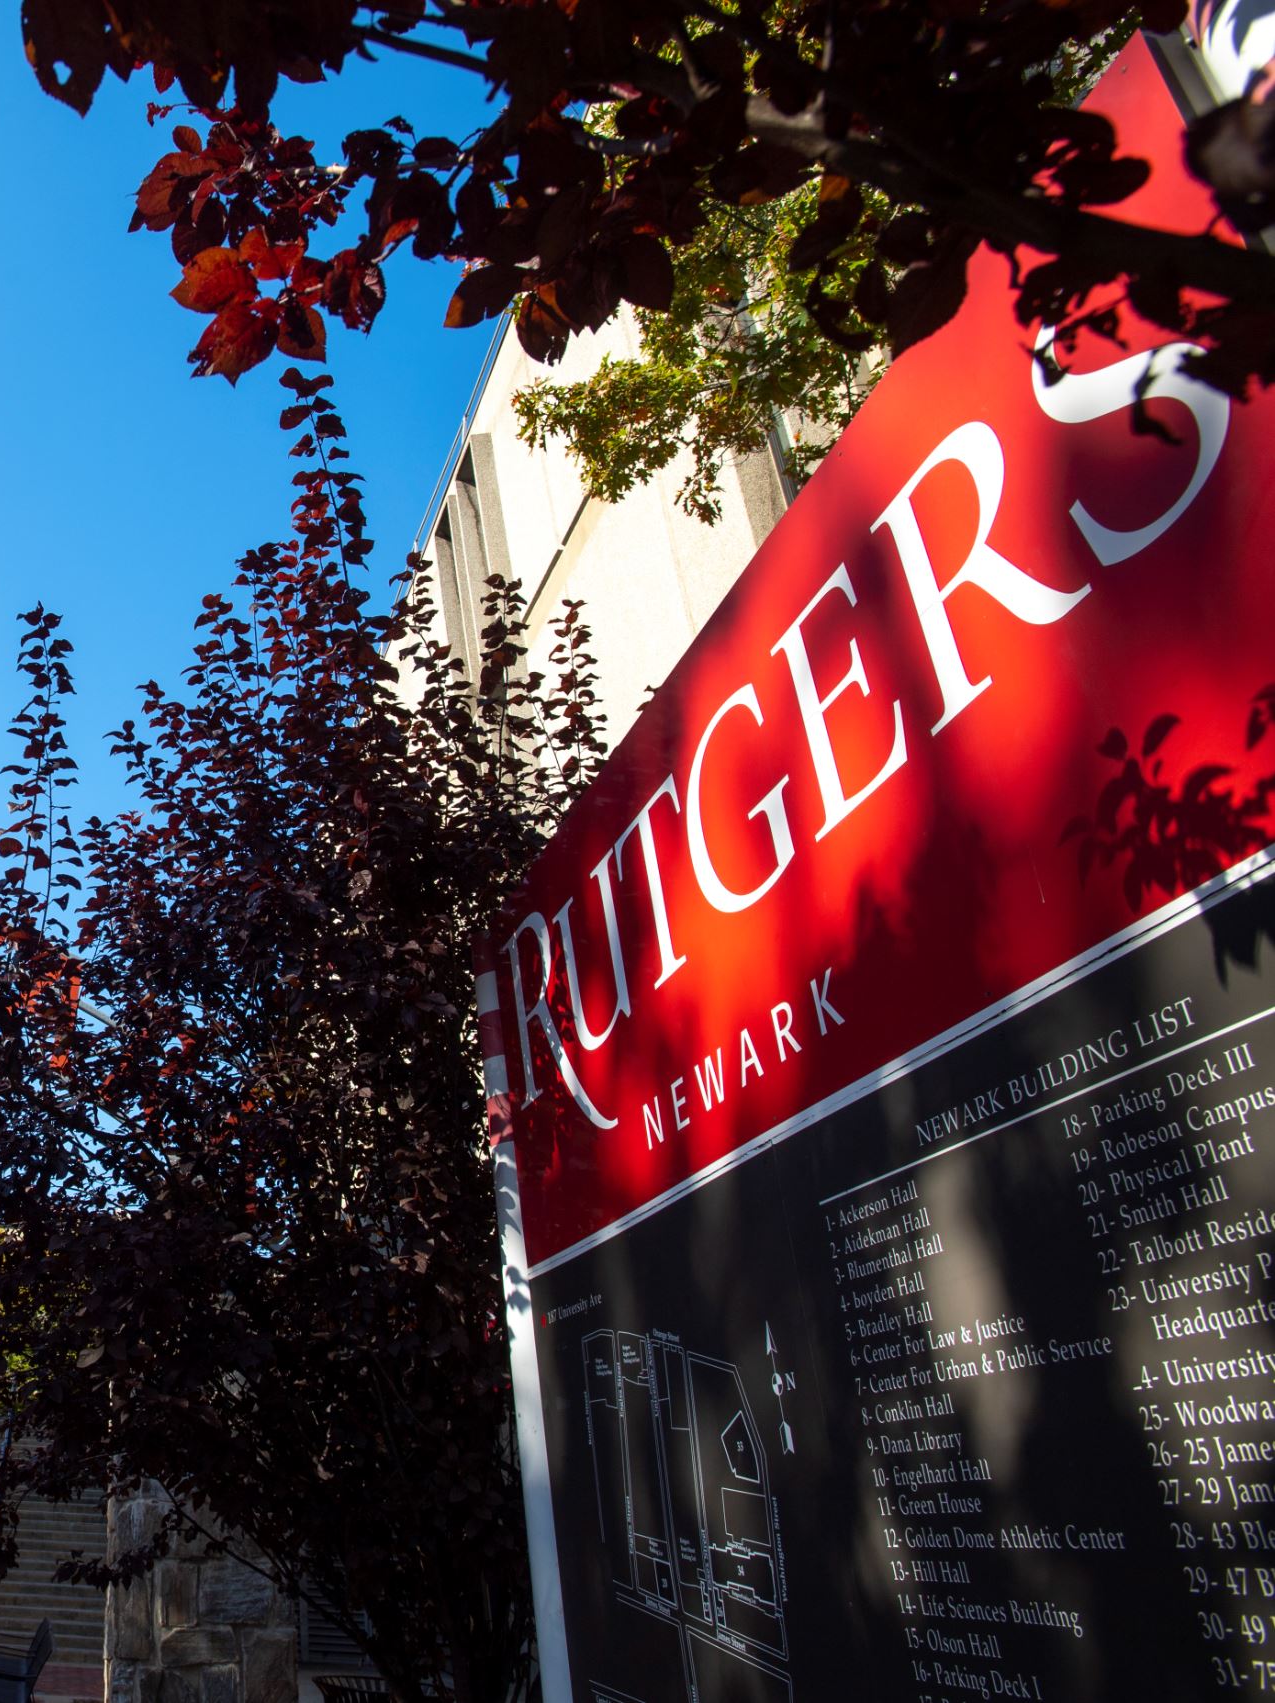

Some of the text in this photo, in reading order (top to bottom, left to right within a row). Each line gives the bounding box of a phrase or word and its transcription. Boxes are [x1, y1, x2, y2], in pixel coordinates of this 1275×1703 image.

[502, 323, 1231, 1130] RUTGERS
[642, 966, 845, 1151] NEWARK
[915, 997, 1195, 1146] NEWARK BUILDING LIST
[1061, 1042, 1256, 1139] 18- Parking Deck III
[1071, 1087, 1275, 1173] 19- Robeson Campus
[1078, 1131, 1255, 1207] 20- Physical Plant
[825, 1179, 919, 1232] 1- Ackerson Hall
[1087, 1175, 1229, 1237] 21- Smith Hall
[830, 1207, 931, 1259] 2- Aidekman Hall
[1097, 1248, 1126, 1274] 22-
[1129, 1229, 1204, 1265] Talbott
[834, 1233, 944, 1285] 3- Blumenthal Hall
[896, 1271, 925, 1296] Hall
[1107, 1286, 1137, 1311] 23-
[1140, 1262, 1250, 1304] University
[844, 1301, 933, 1341] 5- Bradley Hall
[850, 1313, 1025, 1367] 6- Center For Law & Justice
[785, 1371, 796, 1391] N
[854, 1336, 1113, 1396] 7- Center For Urban & Public Service
[1133, 1365, 1159, 1391] 4-
[875, 1399, 923, 1424] Conklin
[924, 1392, 955, 1417] Hall
[1138, 1404, 1170, 1431] 25-
[880, 1435, 913, 1455] Dana
[913, 1430, 962, 1456] Library
[1147, 1436, 1275, 1470] 26- 25 Jame
[872, 1458, 992, 1492] 10- Engelhard Hall
[1158, 1478, 1191, 1505] 27-
[1195, 1477, 1221, 1504] 29
[877, 1492, 983, 1516] 11- Green House
[883, 1524, 1125, 1550] 12- Golden Dome Athletic Center
[1170, 1522, 1204, 1549] 28-
[1212, 1522, 1236, 1549] 43
[890, 1560, 971, 1584] 13- Hill Hall
[1183, 1566, 1218, 1594] 29-
[1226, 1567, 1247, 1596] 47
[898, 1593, 1084, 1638] 14- Life Sciences Building
[1197, 1611, 1233, 1641] 30-
[1241, 1614, 1267, 1644] 49
[904, 1627, 1003, 1659] 15- Olson Hall
[911, 1659, 932, 1682] 16-
[933, 1661, 990, 1700] Parking
[990, 1669, 1031, 1699] Deck
